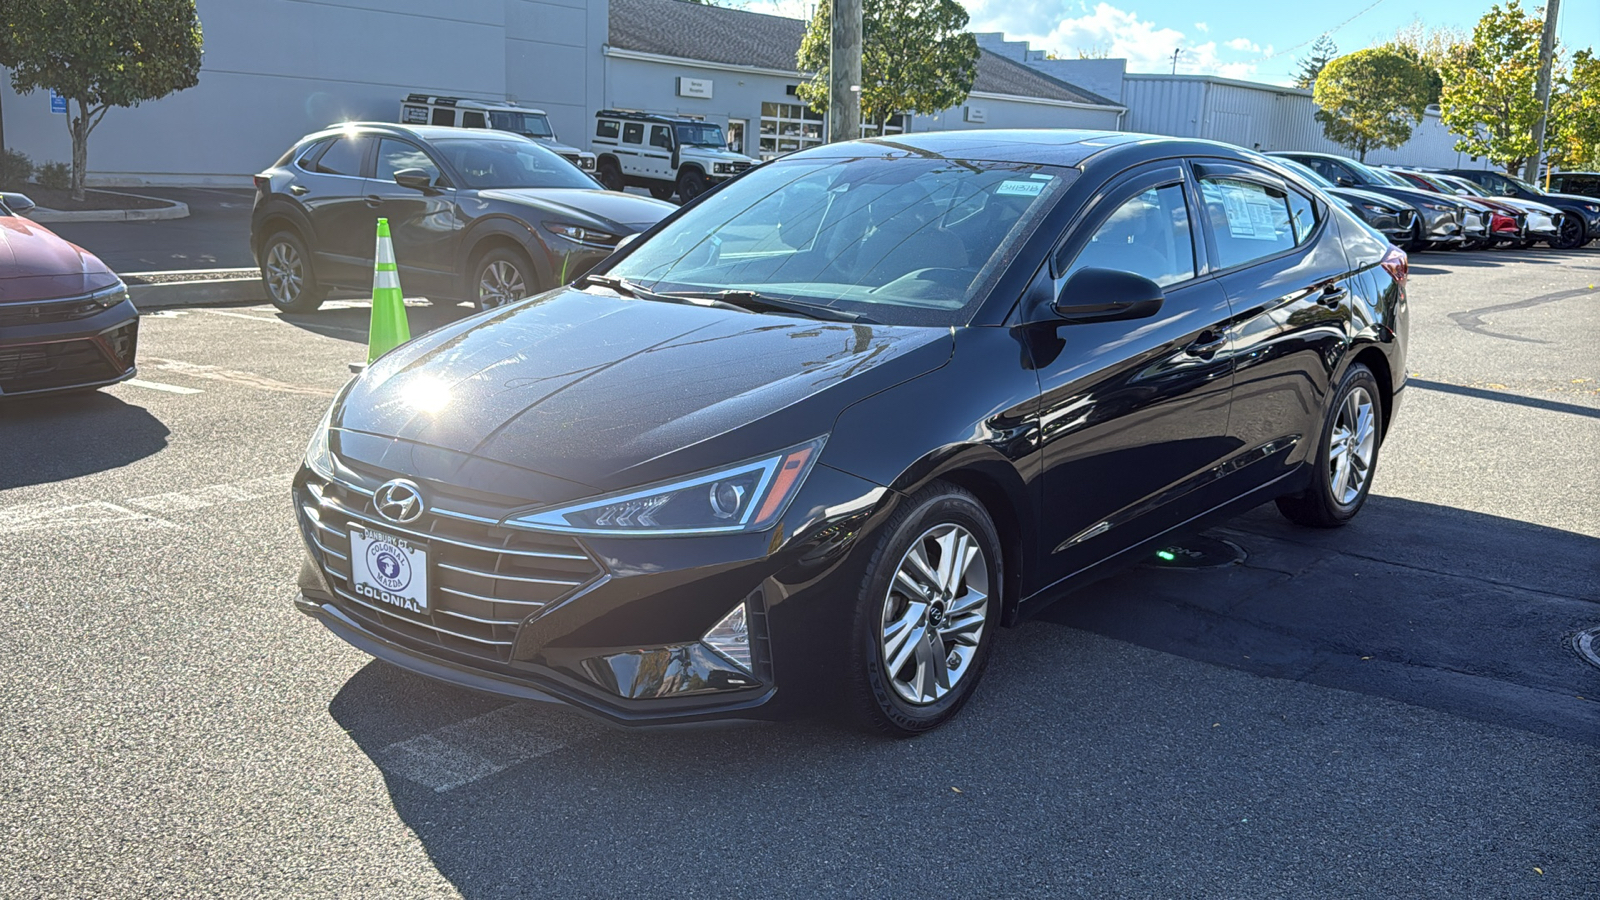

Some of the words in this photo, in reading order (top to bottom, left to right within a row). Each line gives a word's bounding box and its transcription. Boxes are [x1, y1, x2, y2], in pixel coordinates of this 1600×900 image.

[371, 543, 406, 567] COLONIAL
[376, 572, 403, 588] MAZDA
[355, 584, 421, 614] COLONIAL
